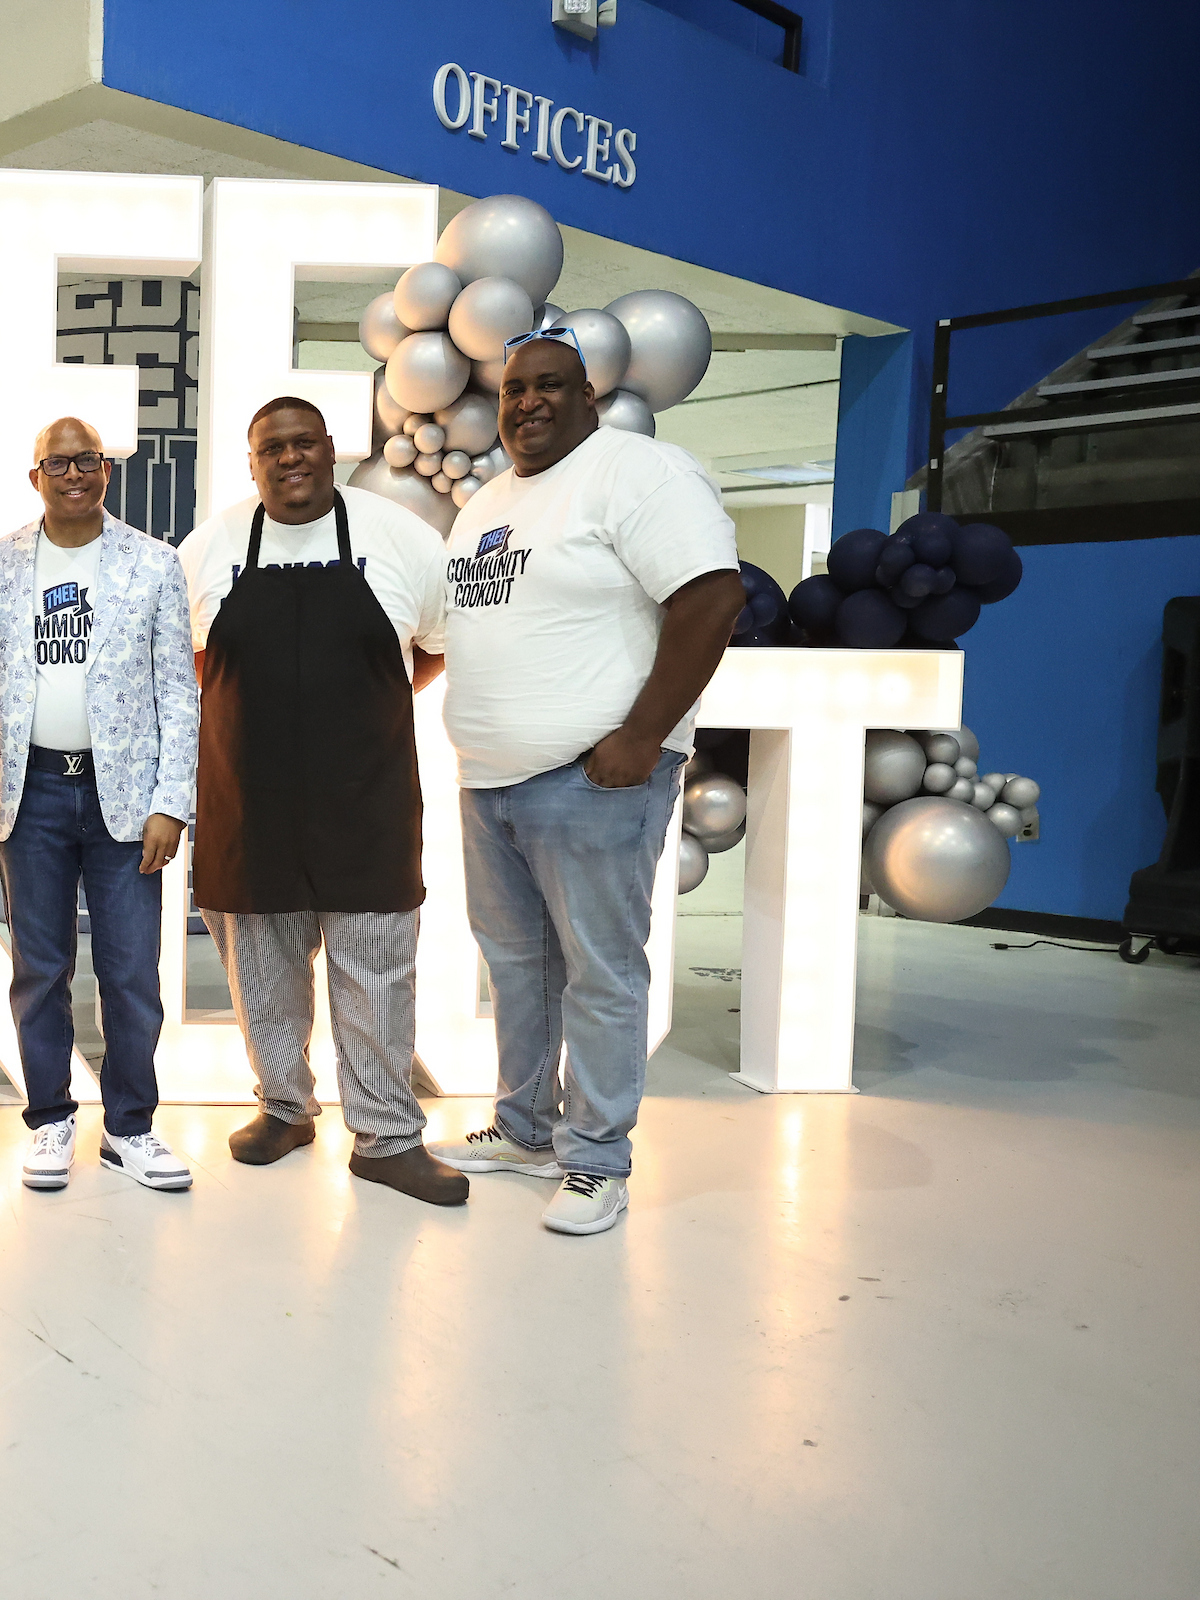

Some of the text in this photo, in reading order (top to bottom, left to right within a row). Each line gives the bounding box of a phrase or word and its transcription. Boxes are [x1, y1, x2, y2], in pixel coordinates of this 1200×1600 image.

[433, 62, 637, 188] OFFICES
[480, 527, 508, 553] THEE
[446, 548, 532, 583] COMMUNITY
[45, 585, 78, 610] THEE
[454, 577, 515, 608] COOKOUT
[34, 612, 94, 639] MMUN
[34, 639, 90, 665] OOKO
